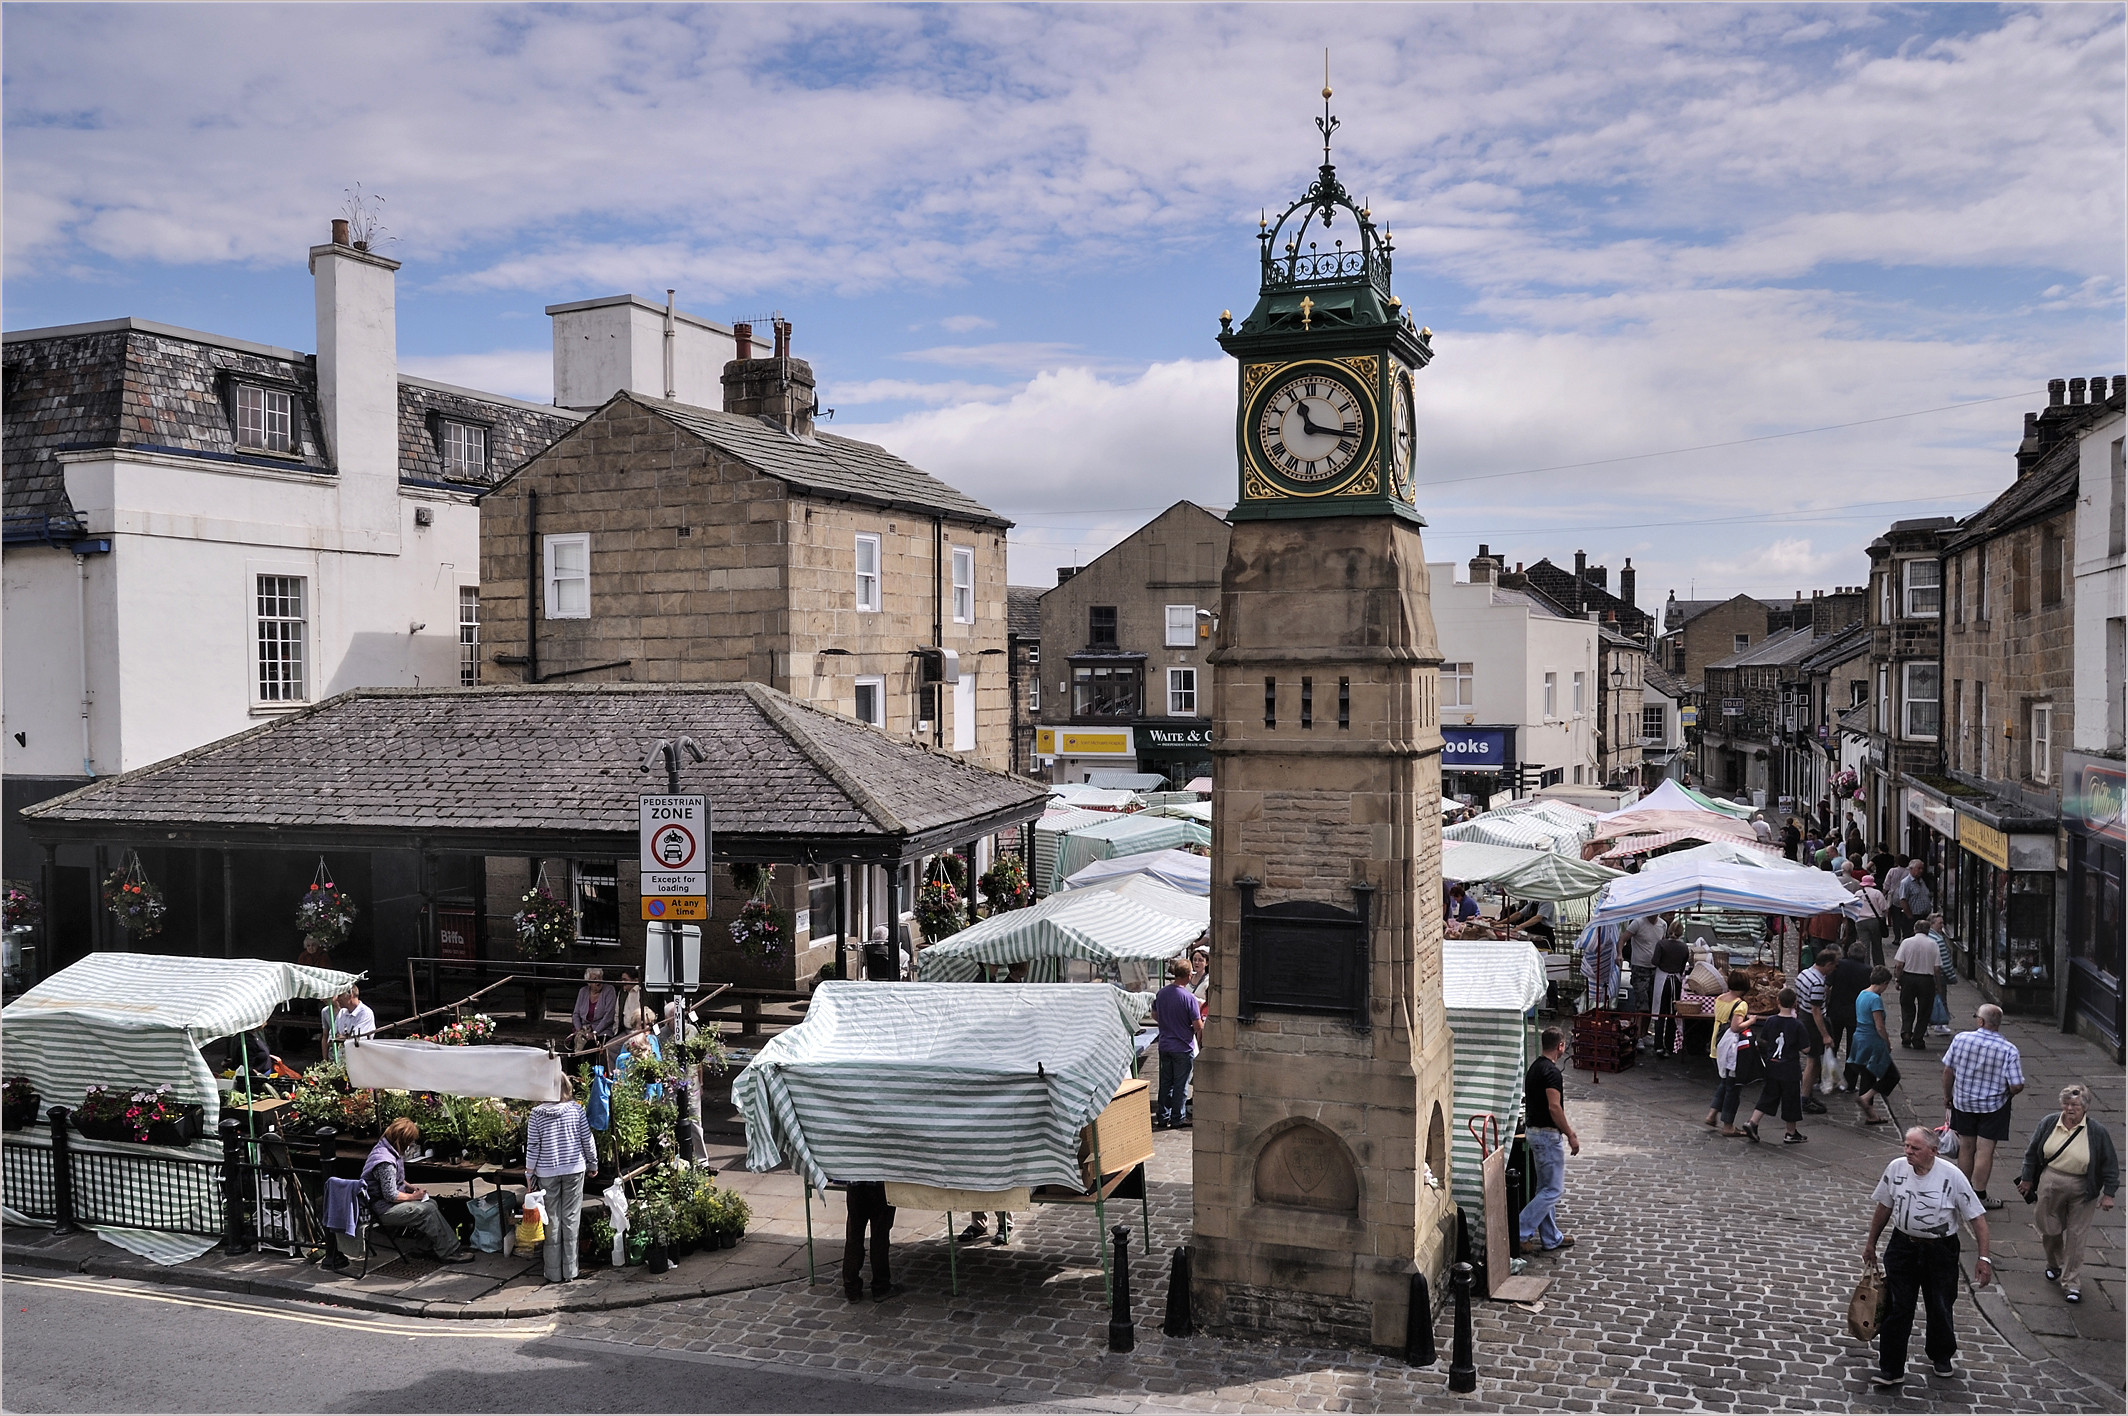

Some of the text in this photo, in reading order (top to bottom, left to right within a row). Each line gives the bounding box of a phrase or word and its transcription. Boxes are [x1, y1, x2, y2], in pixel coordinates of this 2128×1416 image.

[1149, 729, 1184, 742] WAITE
[1187, 729, 1202, 742] &
[1440, 738, 1489, 753] ooks
[643, 798, 702, 806] PEDESTRIAN
[651, 807, 694, 819] ZONE
[651, 875, 696, 885] Except for
[658, 884, 690, 893] loading
[671, 898, 699, 908] At any
[675, 907, 695, 916] time
[440, 929, 464, 944] Biffa
